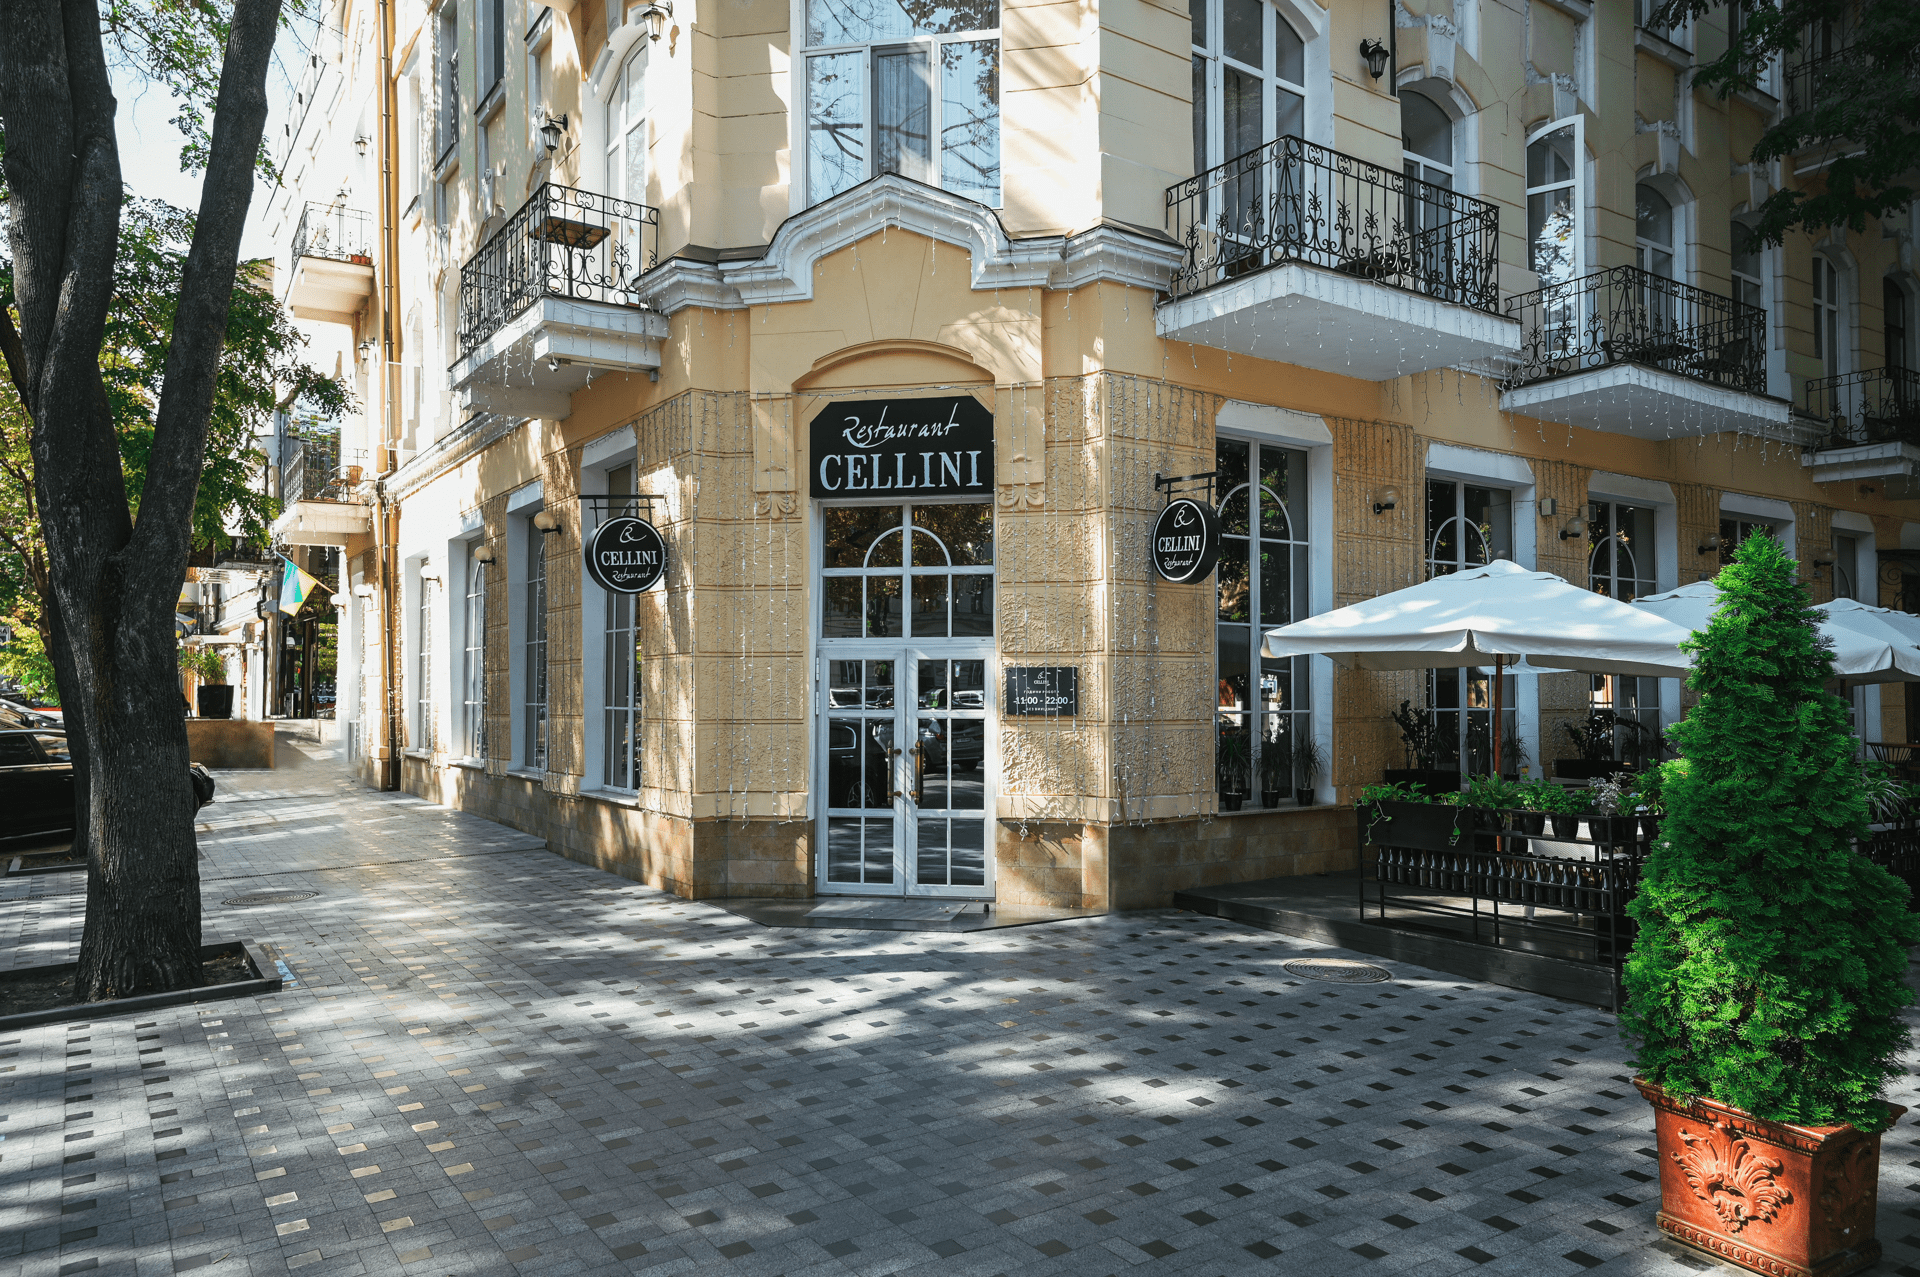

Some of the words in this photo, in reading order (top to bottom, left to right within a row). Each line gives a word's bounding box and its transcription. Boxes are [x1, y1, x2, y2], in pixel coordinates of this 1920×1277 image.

[842, 403, 959, 448] Restaurant
[820, 451, 983, 490] CELLINI
[1158, 535, 1200, 552] CELLINI
[601, 550, 658, 566] CELLINI
[612, 567, 651, 582] Restaurant
[1016, 697, 1038, 705] 11:00
[1045, 697, 1068, 705] 22:00
